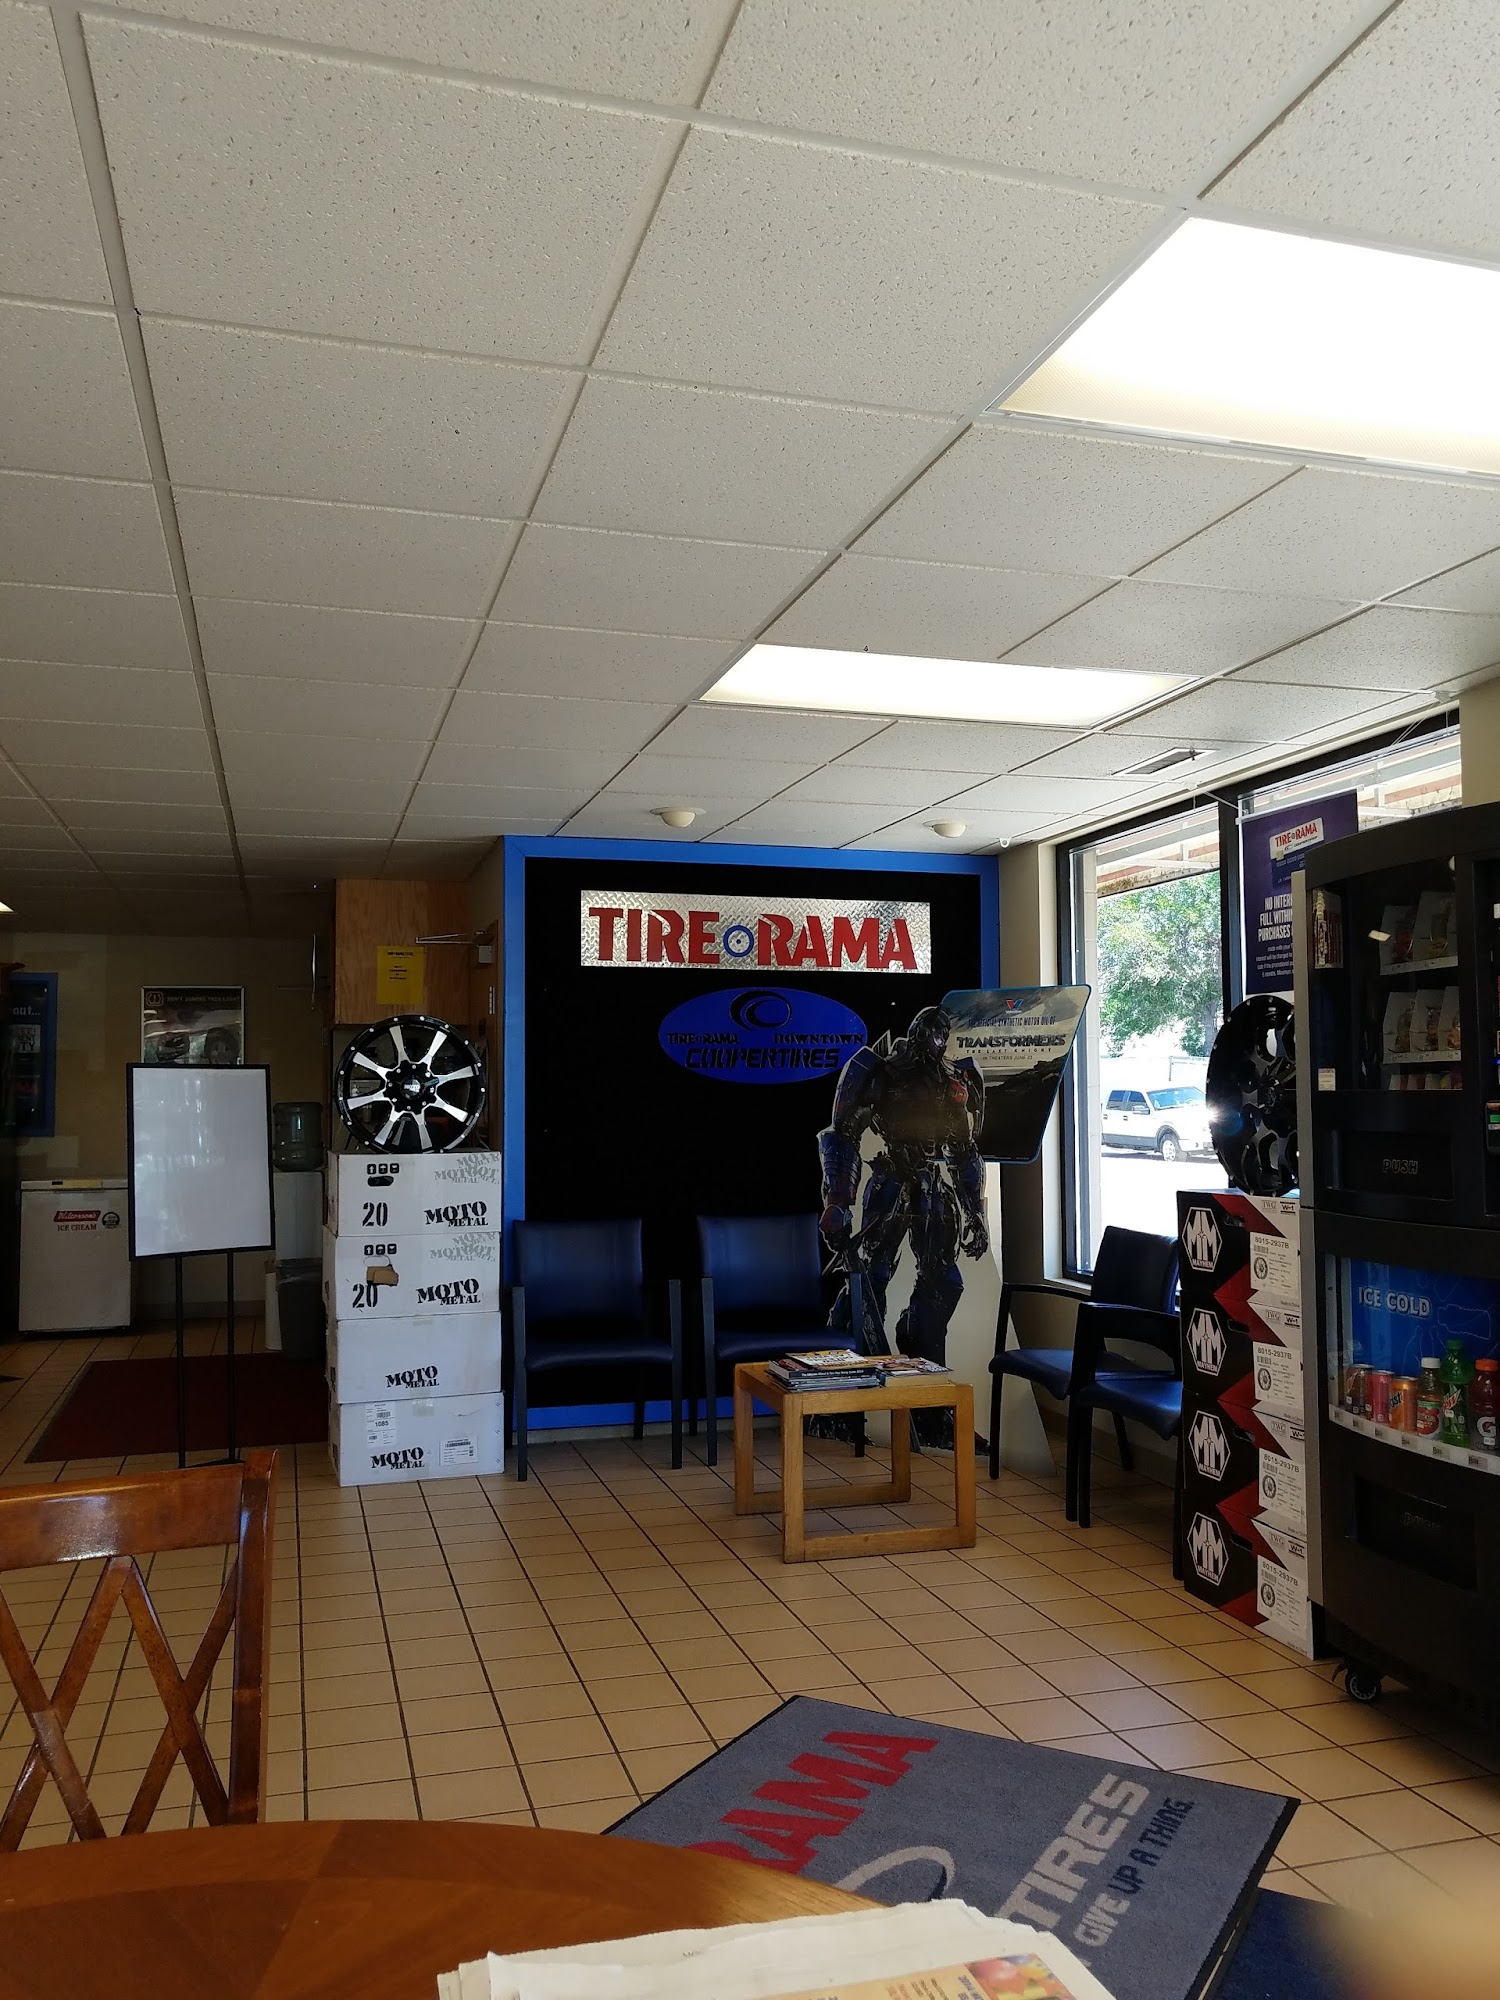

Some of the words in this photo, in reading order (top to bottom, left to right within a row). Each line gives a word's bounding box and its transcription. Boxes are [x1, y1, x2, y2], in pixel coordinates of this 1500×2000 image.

[1275, 833, 1292, 848] TIRE
[1295, 823, 1318, 840] RAMA
[1264, 896, 1273, 911] NO
[1259, 912, 1273, 927] FULL
[588, 906, 720, 964] TIRE
[757, 912, 919, 970] RAMA
[1257, 924, 1291, 942] PURCHASES
[773, 1032, 864, 1044] DOWNTOWN
[956, 1033, 1067, 1048] TRANSFORMERS
[1382, 1158, 1419, 1175] PUSH
[362, 1201, 388, 1227] 20
[423, 1201, 488, 1225] MOTO
[71, 1223, 97, 1231] CREAM
[448, 1217, 489, 1228] METAL
[1192, 1258, 1214, 1269] MAYHEM
[352, 1283, 379, 1309] 20
[415, 1278, 480, 1304] MOTO
[440, 1294, 481, 1306] METAL
[1357, 1286, 1382, 1309] ICE
[1385, 1290, 1431, 1318] COLD
[1196, 1360, 1218, 1372] MAYHEM
[385, 1365, 438, 1388] MOTO
[405, 1379, 440, 1389] METAL
[1476, 1415, 1497, 1438] G
[371, 1447, 425, 1469] MOTO
[390, 1460, 425, 1470] METAL
[993, 1771, 1151, 1931] TIRES
[1106, 1864, 1146, 1895] UP
[1128, 1848, 1161, 1867] A
